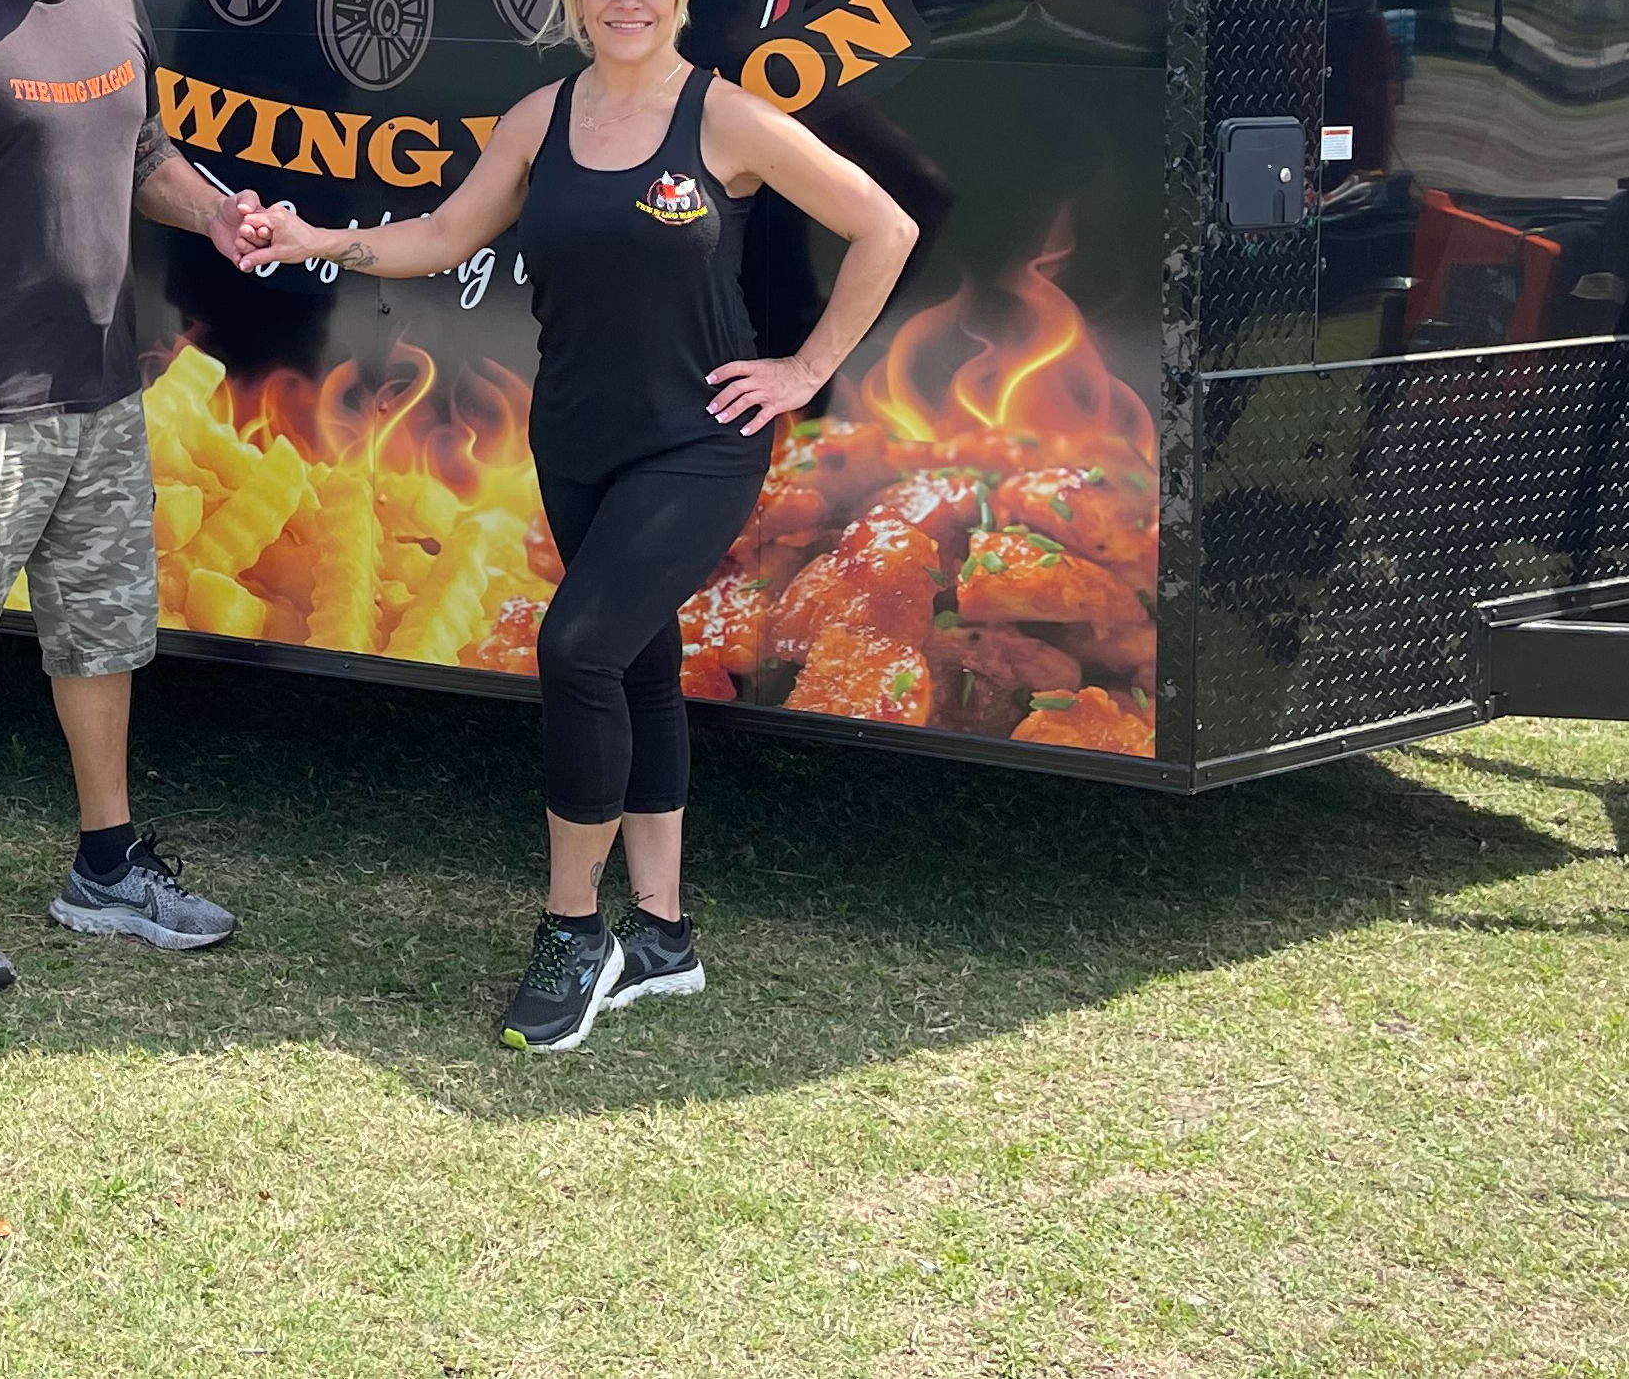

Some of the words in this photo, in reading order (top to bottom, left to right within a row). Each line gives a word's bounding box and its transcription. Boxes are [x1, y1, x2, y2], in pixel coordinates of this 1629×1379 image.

[9, 78, 52, 103] THE
[49, 80, 89, 104] WING
[85, 59, 136, 99] WAGON
[154, 66, 453, 188] WING
